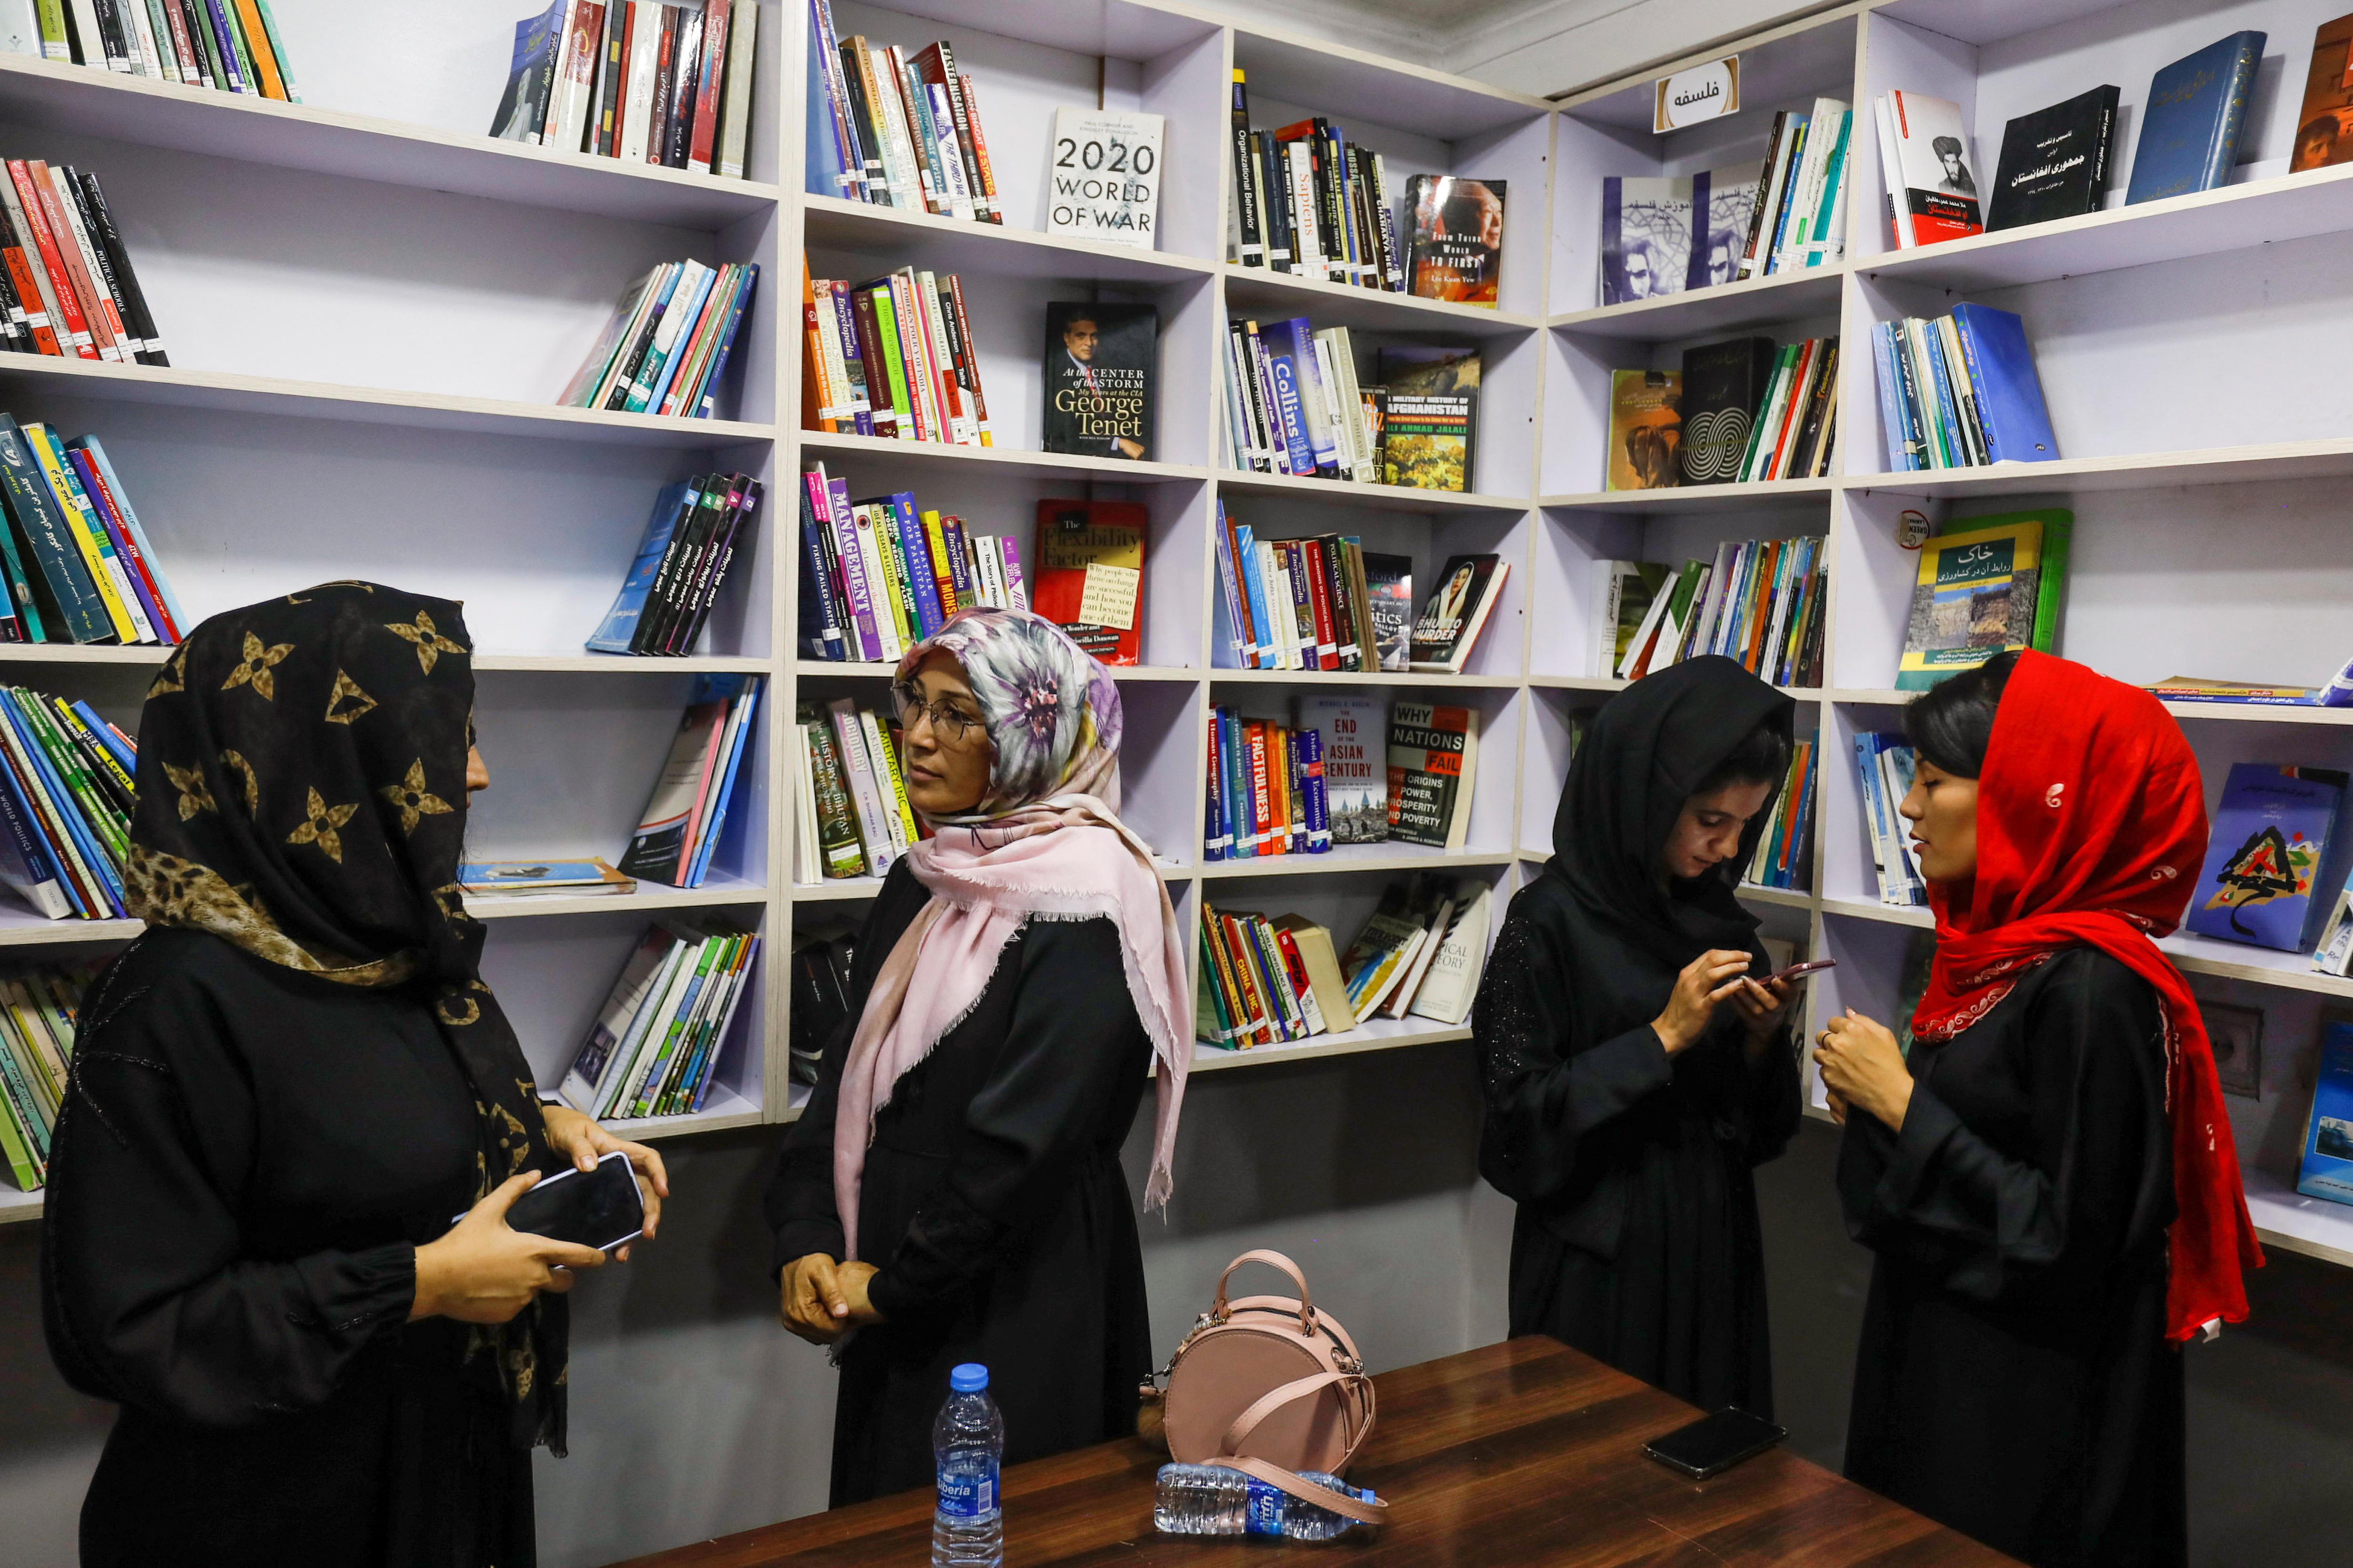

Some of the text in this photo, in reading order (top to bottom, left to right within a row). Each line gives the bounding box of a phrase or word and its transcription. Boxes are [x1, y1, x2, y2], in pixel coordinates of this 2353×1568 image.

[941, 48, 968, 130] EASTERNISATION
[1674, 81, 1720, 107] فلسفه
[962, 77, 976, 111] CHETAN
[970, 112, 984, 145] BHAGAT
[979, 158, 995, 195] STATES
[2037, 137, 2052, 148] تخریب
[2056, 130, 2072, 141] تاسیس
[1056, 137, 1154, 175] 2020
[1347, 149, 1360, 186] MOSSAD
[1238, 130, 1255, 230] Organizational Behavior
[2011, 154, 2085, 187] جمهوری افغانستان
[1056, 176, 1150, 202] WORLD
[93, 193, 104, 209] سیاسی
[100, 210, 111, 226] معاصر
[1299, 173, 1313, 236] Sapiens
[1628, 201, 1659, 209] فلسفه
[1053, 206, 1150, 232] OF WAR
[1377, 200, 1389, 252] CHANAKYA
[1431, 256, 1479, 268] TO FIRST
[97, 250, 126, 312] POLITICAL SCHOOLS
[837, 297, 854, 357] Encyclopedia
[904, 288, 926, 392] FOREIGN POLICY OF INDIA
[949, 321, 960, 353] Anderson
[958, 368, 966, 386] Talks
[1063, 368, 1144, 378] At the CENTER
[1073, 378, 1143, 389] of the STORM
[1055, 389, 1143, 420] George
[1276, 363, 1299, 438] Collins
[1388, 403, 1468, 416] AFGHANISTAN
[1075, 412, 1143, 437] Tenet
[53, 468, 79, 512] فزیک عمومی
[811, 477, 816, 492] 3
[816, 479, 823, 494] 4
[33, 508, 53, 530] کیمیای
[46, 530, 64, 552] کانکور
[1064, 520, 1080, 529] The
[128, 544, 140, 558] MZP
[680, 543, 692, 568] تمرینات
[833, 493, 871, 613] MANAGEMENT
[913, 523, 933, 590] THE BATTLE
[948, 533, 965, 588] Encyclopedia
[1044, 547, 1097, 566] Factor
[1958, 544, 1993, 564] خاک
[655, 541, 676, 592] تمرینات تاریخ عمومی
[689, 541, 719, 610] تمرینات بیولوژی عمومی
[706, 547, 733, 608] تمرینات پشتو عمومی
[812, 544, 823, 570] FIXING
[818, 572, 829, 599] FAILED
[891, 517, 917, 613] TOEFL GRAMMAR FLASH
[1089, 565, 1103, 575] Why
[1104, 569, 1124, 579] people
[1330, 544, 1344, 610] POLITICAL SCIENCE
[1938, 562, 2011, 582] روابط آن در کشاورزی
[667, 582, 677, 602] عمومی
[1084, 593, 1133, 608] and how you
[1082, 603, 1131, 616] can become
[1097, 615, 1105, 623] of
[1107, 616, 1129, 626] them
[1412, 629, 1457, 640] MURDER
[1417, 618, 1462, 629] BHUTTO
[1335, 719, 1357, 733] END
[1397, 706, 1431, 723] WHY
[868, 726, 884, 771] PAKISTAN
[1330, 744, 1363, 759] ASIAN
[1394, 728, 1463, 750] NATIONS
[879, 731, 901, 783] MILITARY
[1325, 763, 1371, 777] CENTURY
[1428, 755, 1458, 771] FAIL
[1252, 736, 1269, 822] FACTFULNESS
[1408, 776, 1443, 788] ORIGINS
[1401, 786, 1433, 800] POWER,
[833, 793, 850, 835] BHUTAN
[1237, 959, 1258, 1014] CHINA INC.
